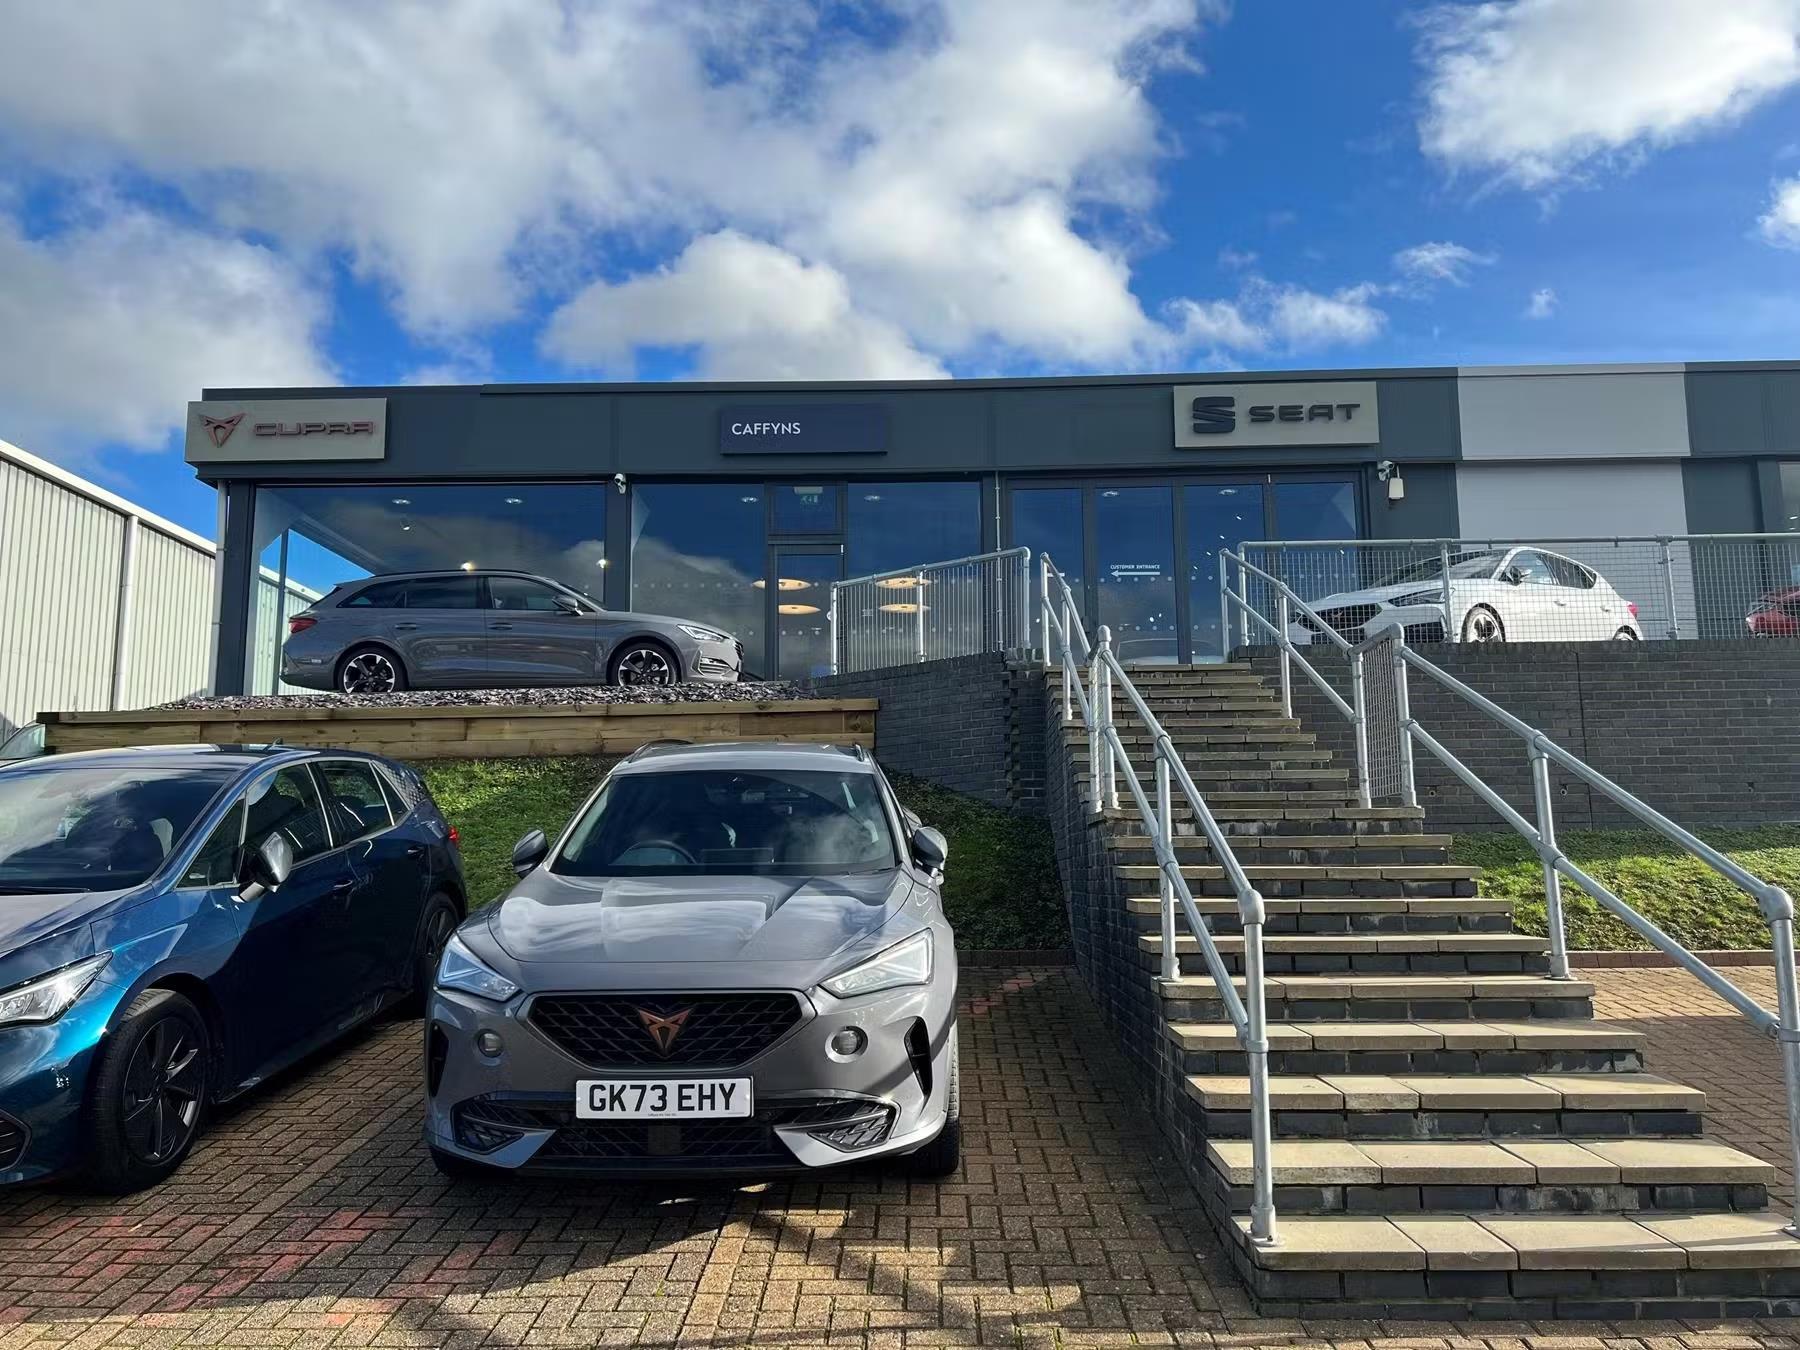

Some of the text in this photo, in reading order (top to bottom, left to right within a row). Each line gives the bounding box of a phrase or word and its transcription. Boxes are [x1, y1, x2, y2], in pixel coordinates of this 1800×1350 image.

[1249, 403, 1361, 423] SEAT
[254, 421, 374, 437] CUPRA
[731, 422, 801, 435] CAFFYNS
[589, 1083, 736, 1112] GK73 EHY
